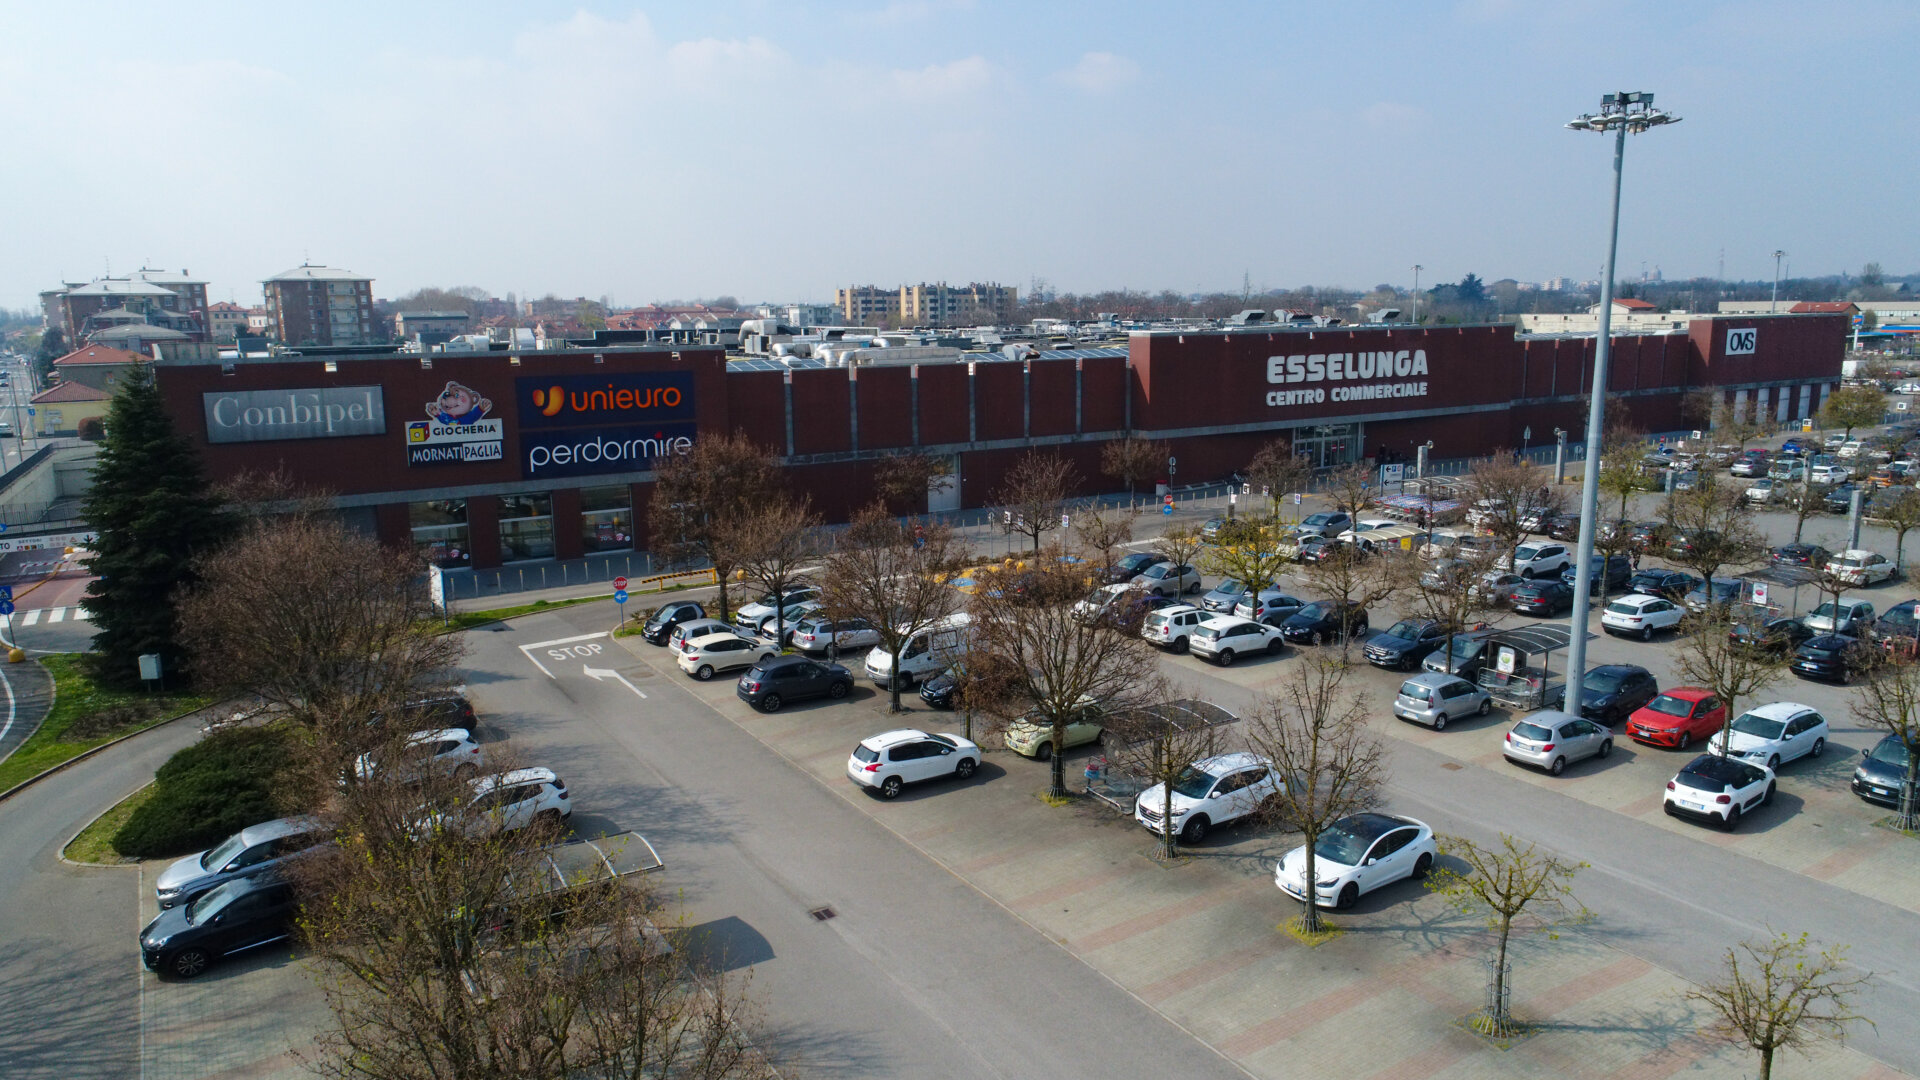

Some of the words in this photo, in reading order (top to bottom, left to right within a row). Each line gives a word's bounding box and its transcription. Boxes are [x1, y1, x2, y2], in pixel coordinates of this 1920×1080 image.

[1730, 332, 1755, 351] OVS
[1266, 349, 1429, 384] ESSELUNGA
[571, 383, 682, 412] unieuro
[1266, 388, 1326, 406] CENTRO
[1330, 381, 1428, 402] COMMERCIALE
[213, 391, 377, 433] Conbipel
[433, 424, 496, 436] GIOCHERIA
[412, 446, 463, 463] MORNATI
[464, 444, 501, 459] PAGLIA
[529, 430, 692, 473] perdormire
[547, 643, 602, 661] STOP
